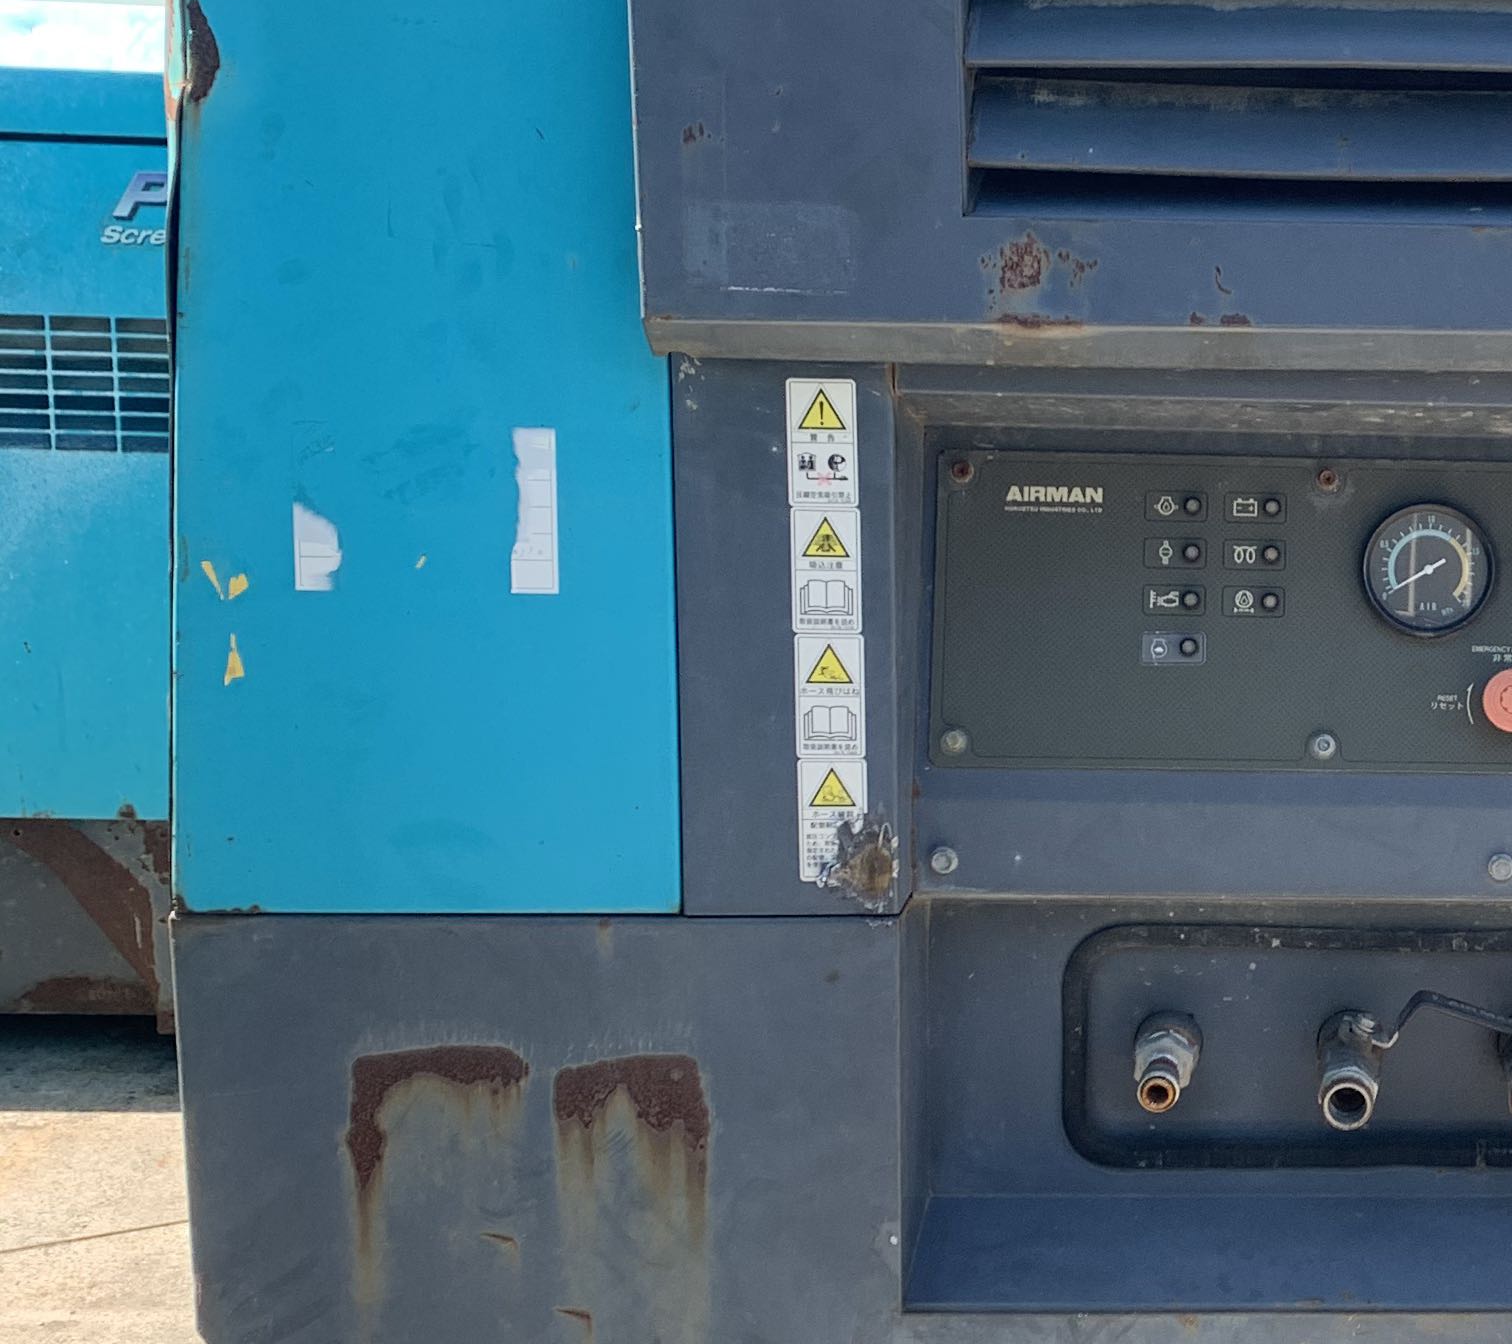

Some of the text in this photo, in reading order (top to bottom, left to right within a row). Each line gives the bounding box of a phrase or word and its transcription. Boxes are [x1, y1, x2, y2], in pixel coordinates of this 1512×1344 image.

[1006, 485, 1103, 503] AIRMAN
[1430, 702, 1464, 710] リセット
